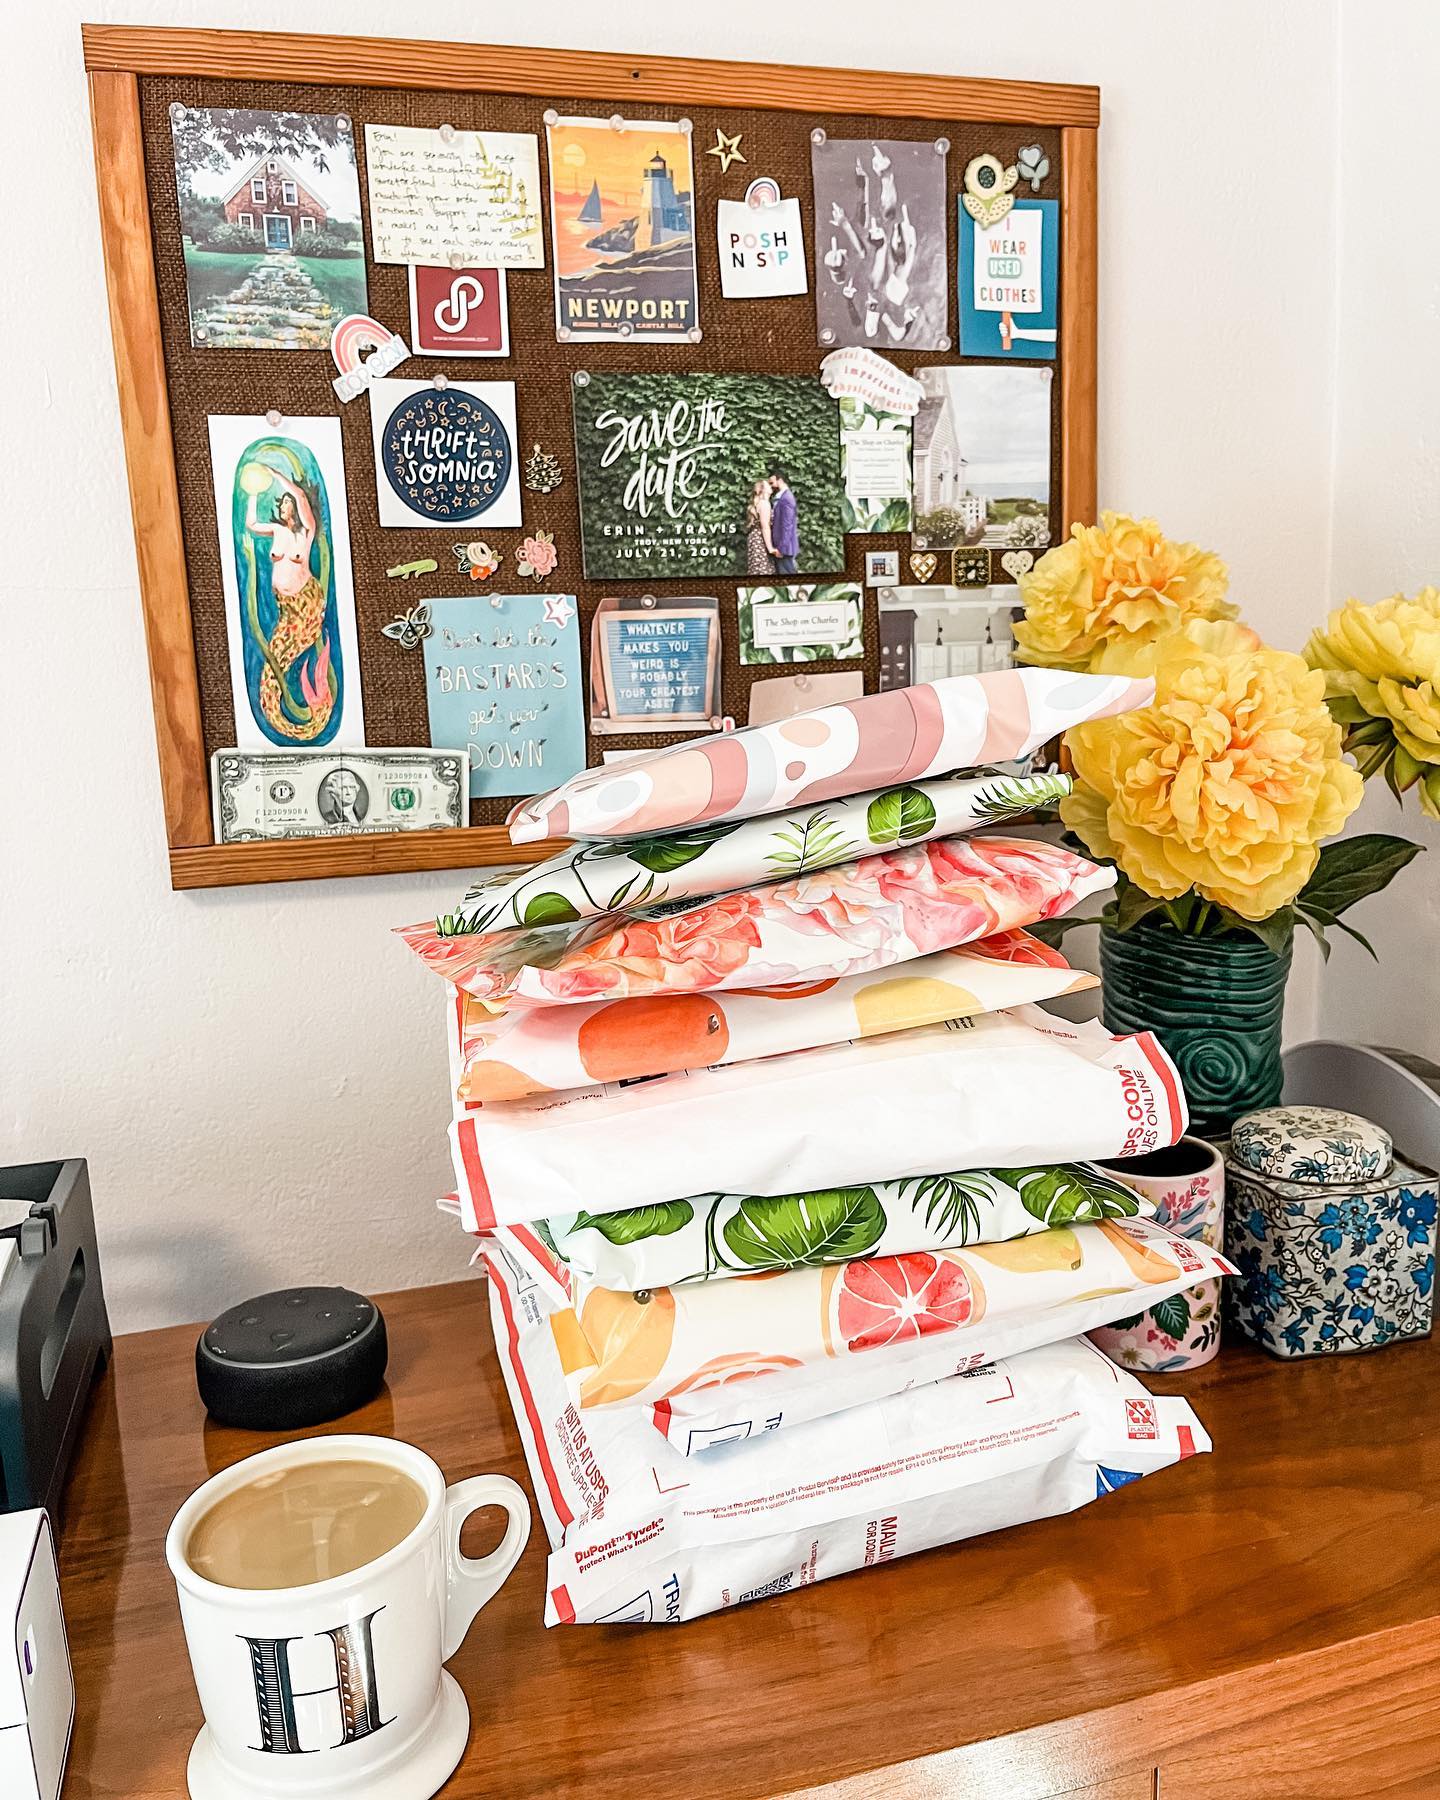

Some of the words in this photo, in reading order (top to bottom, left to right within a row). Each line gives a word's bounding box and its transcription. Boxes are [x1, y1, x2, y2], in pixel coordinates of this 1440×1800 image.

[731, 231, 788, 249] POSH
[989, 239, 1026, 255] WEAR
[733, 252, 744, 269] N
[990, 259, 1021, 275] USED
[980, 287, 1037, 304] CLOTHES
[568, 298, 689, 320] NEWPORT
[844, 365, 902, 396] important
[693, 397, 734, 442] the
[623, 443, 708, 518] date
[603, 525, 645, 536] ERIN
[656, 526, 664, 535] +
[675, 523, 738, 535] TRAVIS
[684, 537, 708, 545] YORK
[615, 548, 652, 559] JULY
[660, 547, 682, 559] 21,
[690, 546, 727, 557] 2018
[626, 622, 686, 635] WHATEVER
[763, 618, 779, 627] The
[780, 617, 798, 627] Shop
[811, 615, 839, 625] Charles
[623, 642, 660, 654] MAKES
[668, 641, 689, 652] YOU
[631, 659, 664, 670] WEIRD
[670, 658, 680, 669] IS
[436, 662, 568, 693] BASTARDS
[631, 670, 688, 682] PROBABLY
[619, 688, 646, 699] YOUR
[650, 685, 700, 698] GREATEST
[644, 698, 676, 710] ASSET
[468, 701, 499, 735] get
[467, 738, 548, 770] DOWN
[222, 757, 240, 778] 2
[442, 759, 458, 777] 2
[1133, 1069, 1158, 1126] ONLINE
[564, 1402, 581, 1431] VISIT
[555, 1417, 571, 1447] ORDER
[563, 1442, 578, 1471] FREE
[573, 1430, 589, 1450] US
[579, 1446, 594, 1466] AT
[697, 1505, 727, 1515] packaging
[744, 1497, 768, 1507] property
[841, 1473, 852, 1482] and
[943, 1442, 963, 1453] Priority
[989, 1432, 1009, 1442] Priority
[1009, 1428, 1021, 1436] Mail
[795, 1491, 816, 1501] federal
[827, 1485, 839, 1493] This
[840, 1479, 864, 1490] package
[905, 1461, 920, 1471] EP14
[979, 1442, 997, 1452] March
[866, 1520, 877, 1539] FOR
[579, 1552, 606, 1574] Protect
[607, 1543, 634, 1559] What's
[235, 1605, 398, 1756] H
